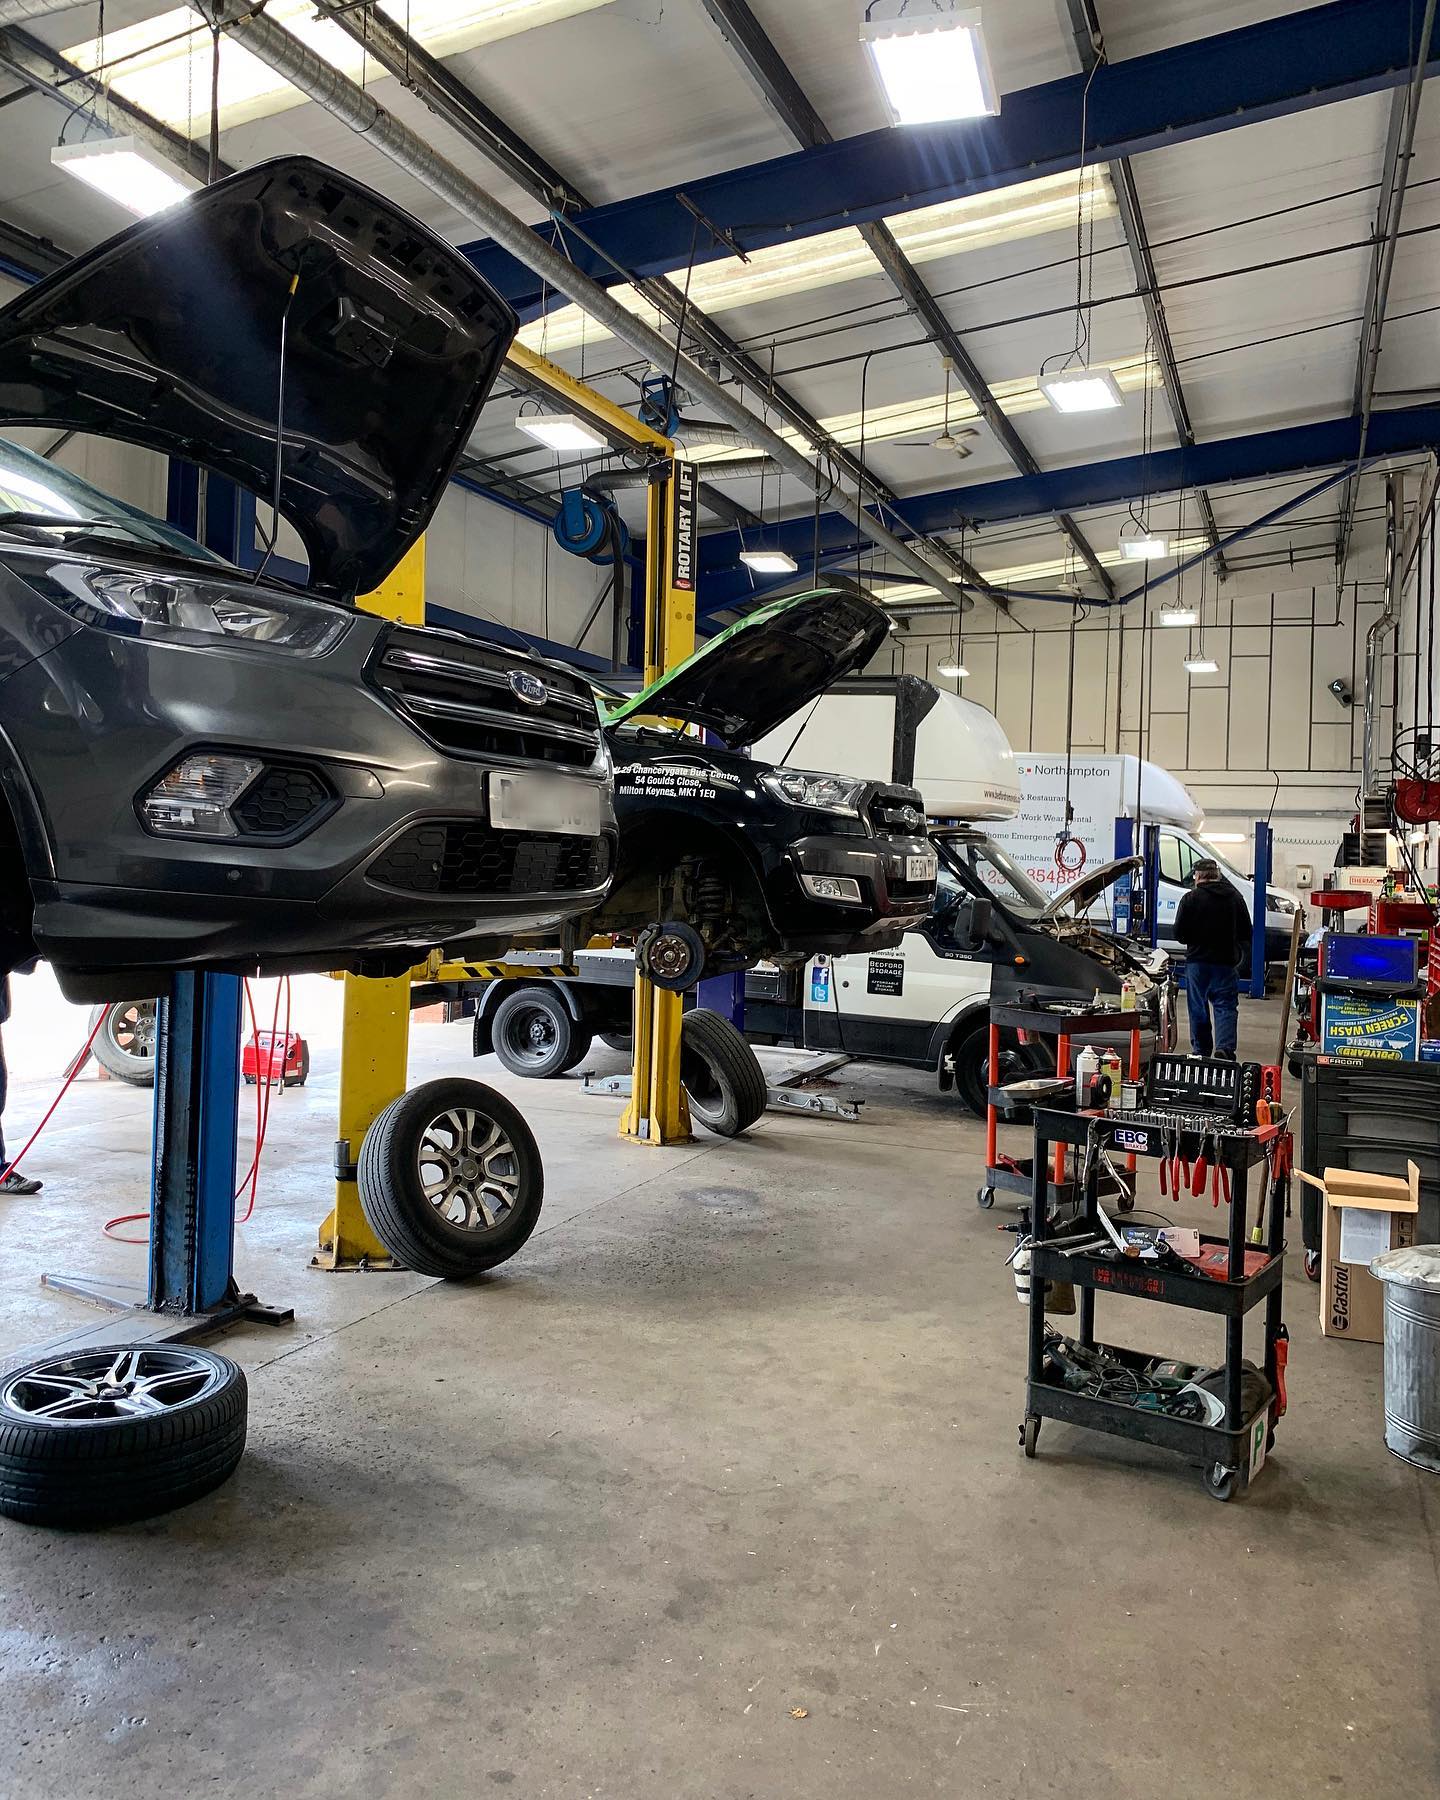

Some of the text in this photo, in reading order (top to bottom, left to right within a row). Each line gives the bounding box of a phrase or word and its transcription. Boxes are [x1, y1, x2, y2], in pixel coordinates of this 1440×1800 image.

[677, 461, 692, 579] ROTARY LIFT
[521, 677, 541, 697] Ford
[632, 765, 688, 777] Chancerygate
[689, 766, 708, 777] Bus.
[710, 769, 741, 783] Centre,
[1034, 765, 1110, 778] Northampton
[635, 776, 702, 788] 54 Goulds Close,
[619, 785, 717, 798] Milton Keynes, MK1 1EQ
[1027, 793, 1067, 802] Restauran
[1021, 813, 1041, 822] Work
[1043, 814, 1064, 823] Wear
[1011, 831, 1057, 843] Emergency
[869, 960, 903, 969] BEDFORD
[869, 967, 903, 976] STORAGE
[1330, 1013, 1408, 1036] SCREEN WASH
[1347, 1037, 1385, 1048] ARCTIC
[1115, 1129, 1148, 1145] EBC
[1332, 1265, 1349, 1316] Castrol
